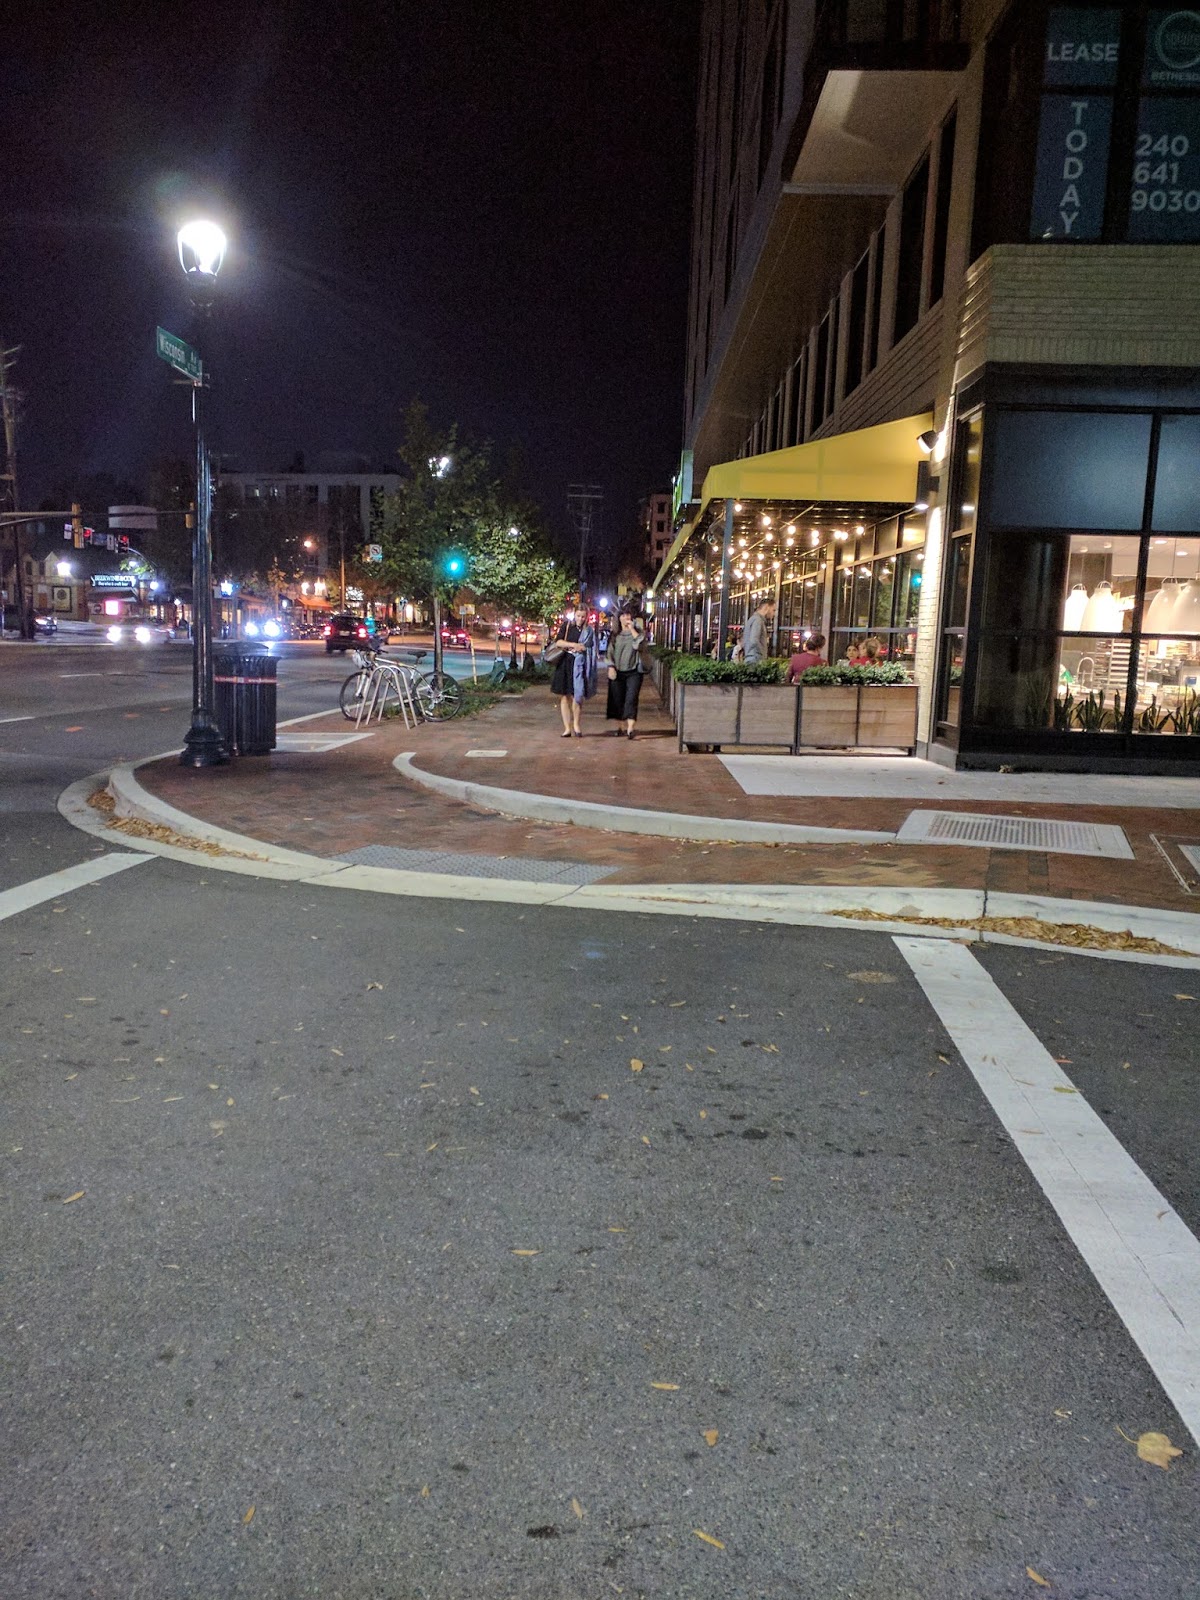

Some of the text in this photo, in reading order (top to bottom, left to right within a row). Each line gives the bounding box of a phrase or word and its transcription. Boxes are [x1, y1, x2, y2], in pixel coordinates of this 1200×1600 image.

[1047, 43, 1120, 61] LEASE
[1135, 134, 1189, 157] 240
[1060, 101, 1088, 234] TODAY
[1133, 161, 1179, 184] 641
[1131, 190, 1200, 212] 9030
